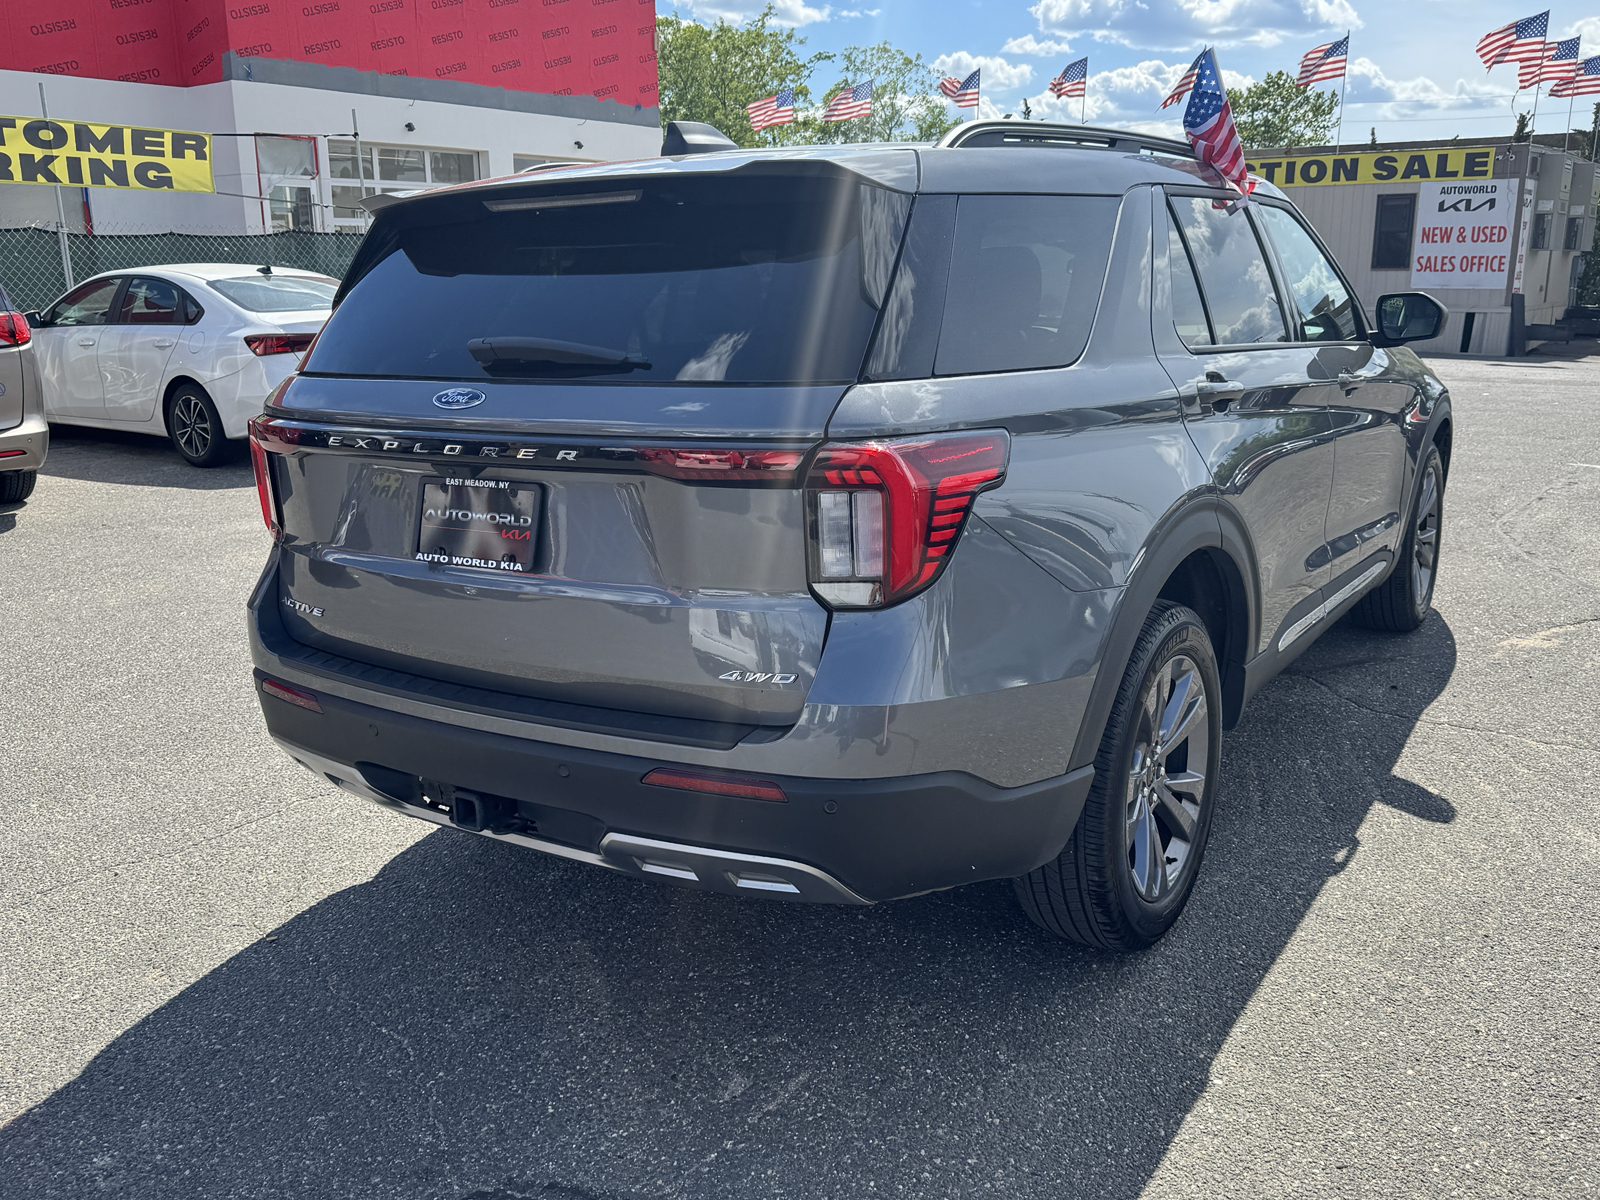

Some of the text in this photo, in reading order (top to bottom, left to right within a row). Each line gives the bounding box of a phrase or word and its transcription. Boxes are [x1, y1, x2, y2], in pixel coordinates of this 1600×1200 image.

[230, 3, 271, 19] RESISTO
[302, 1, 341, 17] RESISTO
[369, 0, 404, 14] RESISTO
[30, 19, 77, 36] RESISTO
[186, 17, 210, 42] RESISTO
[488, 28, 519, 43] RESISTO
[541, 26, 570, 40] RESISTO
[591, 25, 618, 38] RESISTO
[116, 29, 159, 46] RESISTO
[370, 35, 405, 51] RESISTO
[431, 30, 464, 46] RESISTO
[235, 43, 272, 58] ESISTO
[303, 39, 342, 56] RESISTO
[192, 51, 215, 77] RESISTO
[491, 58, 521, 73] RESISTO
[543, 55, 572, 69] RESISTO
[593, 53, 620, 67] RESISTO
[435, 61, 467, 77] RESISTO
[593, 84, 619, 98] RESISTO
[1372, 151, 1490, 180] SALE
[1439, 185, 1497, 195] AUTOWORLD
[1438, 198, 1496, 212] KIA
[1421, 227, 1454, 244] NEW
[1456, 226, 1467, 244] &
[1471, 226, 1508, 243] USED
[1416, 256, 1456, 272] SALES
[1460, 255, 1506, 272] OFFICE
[328, 436, 578, 461] EXPLORER
[424, 508, 532, 527] AUTOWORLD
[502, 529, 531, 541] KIA
[415, 553, 523, 571] AUTO WORLD KIA
[282, 596, 326, 617] ACTIVE
[718, 670, 799, 684] 4WD
